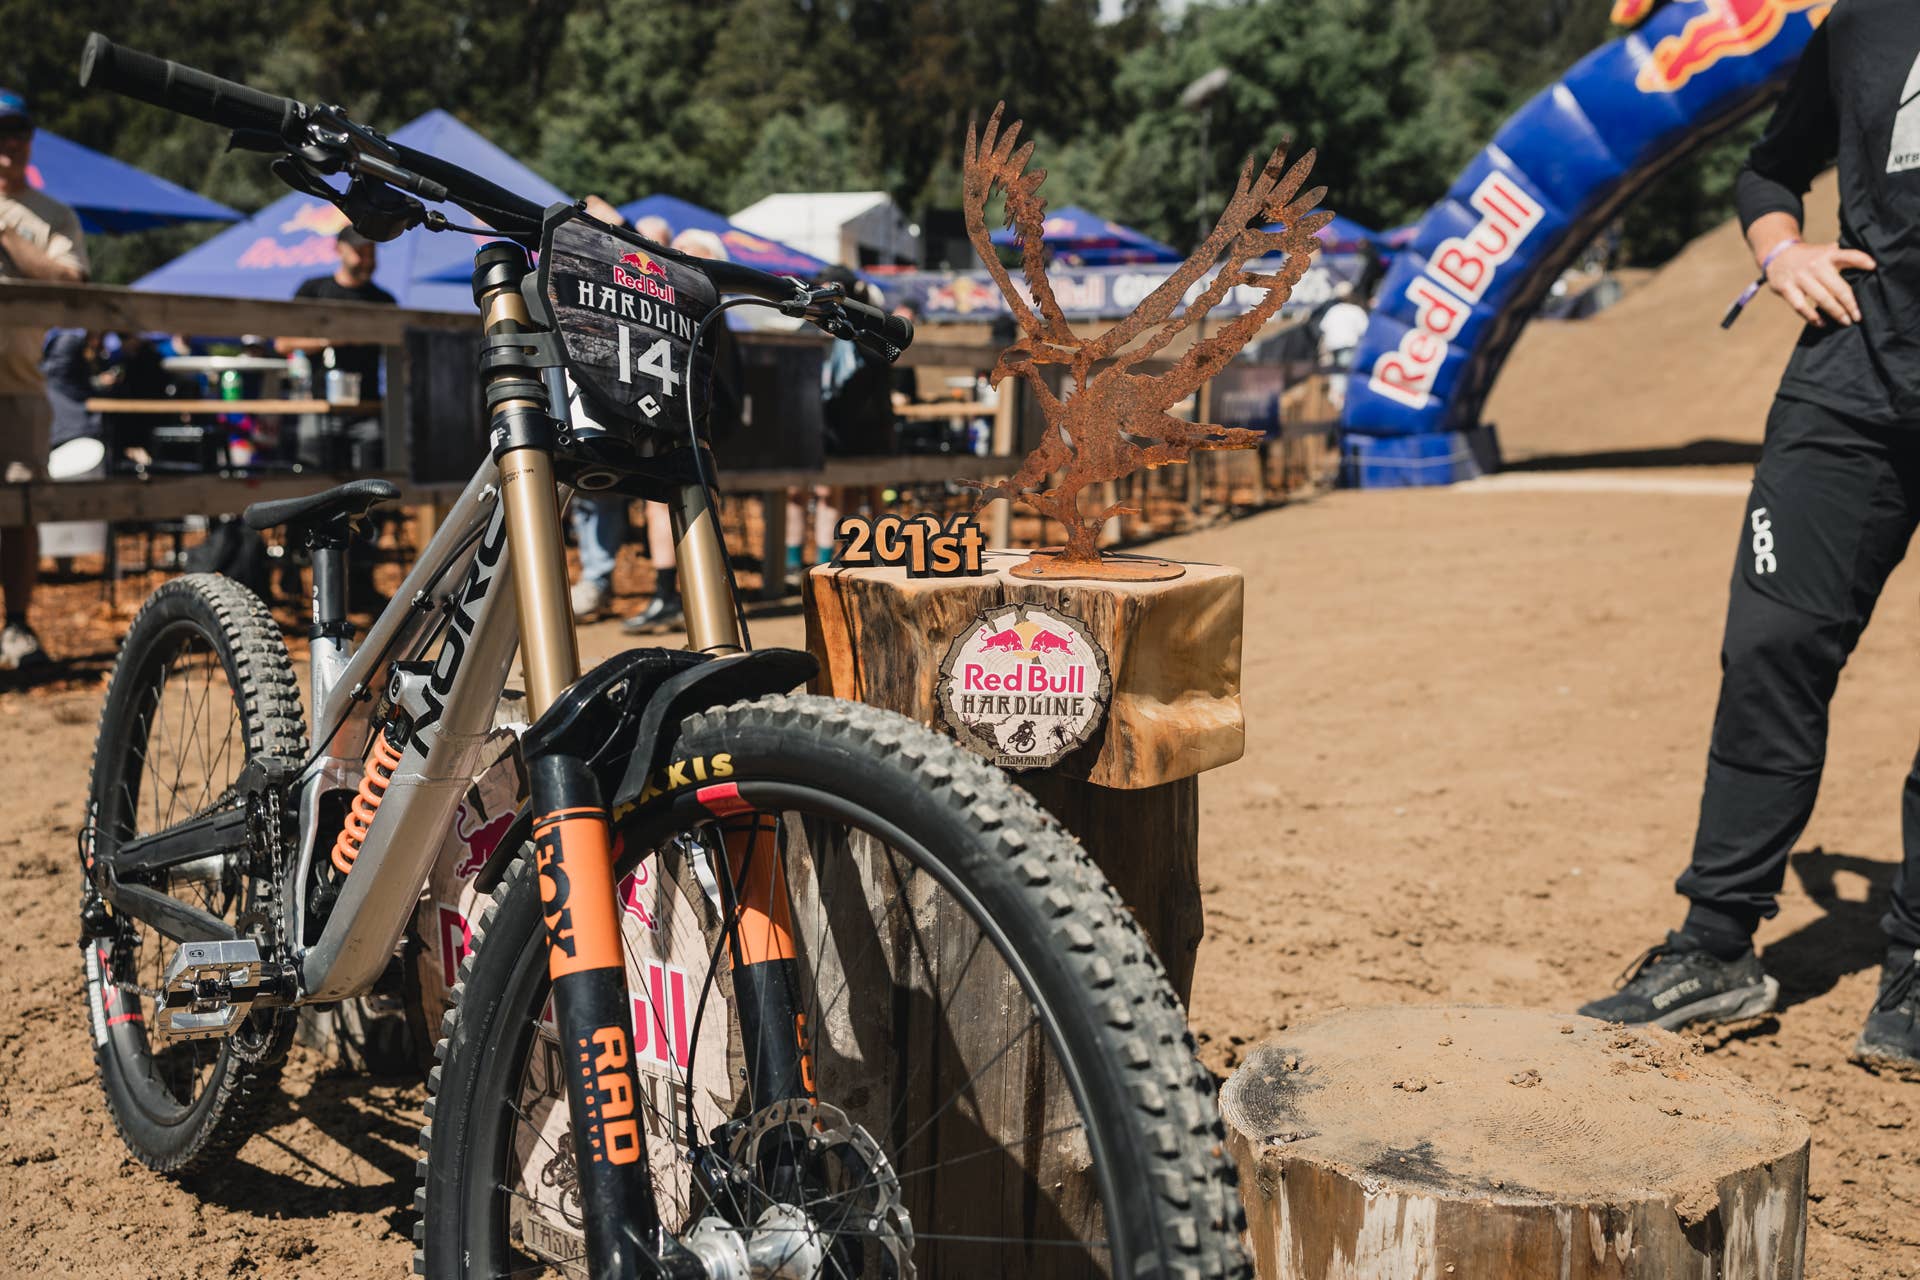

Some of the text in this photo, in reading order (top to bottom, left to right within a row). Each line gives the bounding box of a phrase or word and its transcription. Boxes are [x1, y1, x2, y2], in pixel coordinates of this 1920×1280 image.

[613, 264, 676, 305] Red Bull
[1376, 177, 1539, 402] Red Bull
[616, 324, 681, 398] 14
[901, 522, 983, 573] 1st
[408, 482, 508, 760] NORC
[960, 693, 1085, 717] HARDLINE
[963, 663, 1085, 694] Red Bull
[998, 755, 1048, 766] TASMANIA
[535, 825, 577, 959] FOX
[578, 1038, 603, 1163] PROTOTYPE
[591, 1025, 641, 1166] RAD
